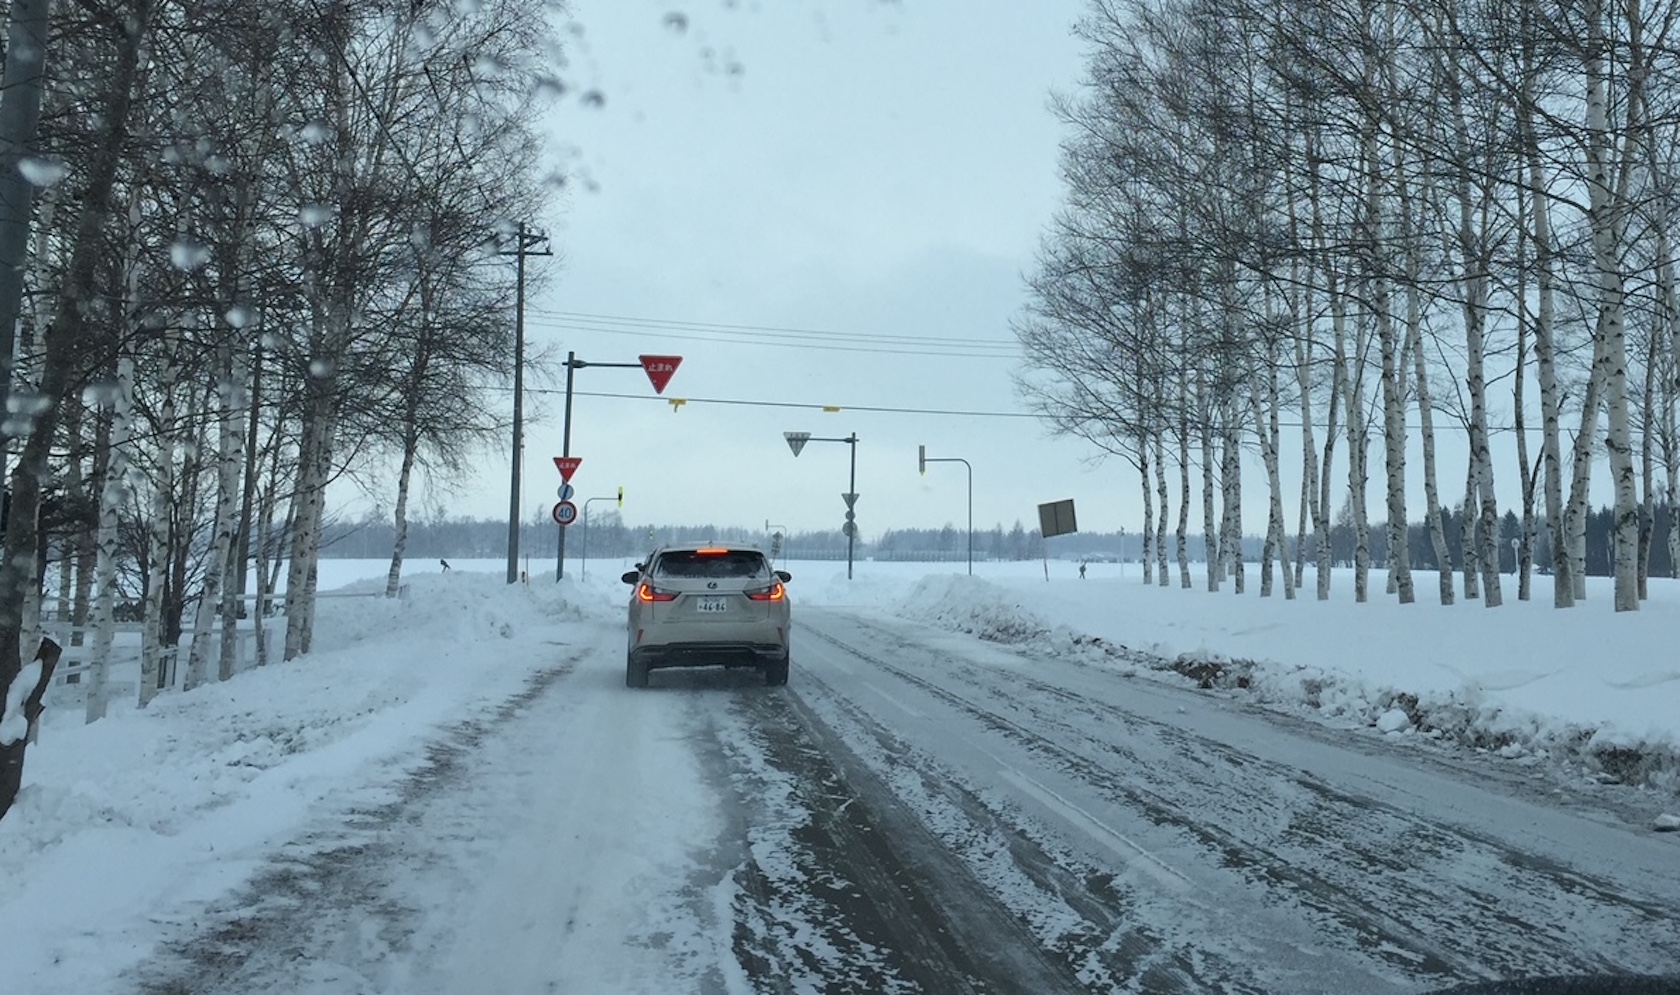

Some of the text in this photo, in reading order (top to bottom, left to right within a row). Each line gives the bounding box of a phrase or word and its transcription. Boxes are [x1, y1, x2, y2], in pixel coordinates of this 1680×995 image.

[648, 363, 673, 372] 止まれ
[558, 507, 572, 519] 40
